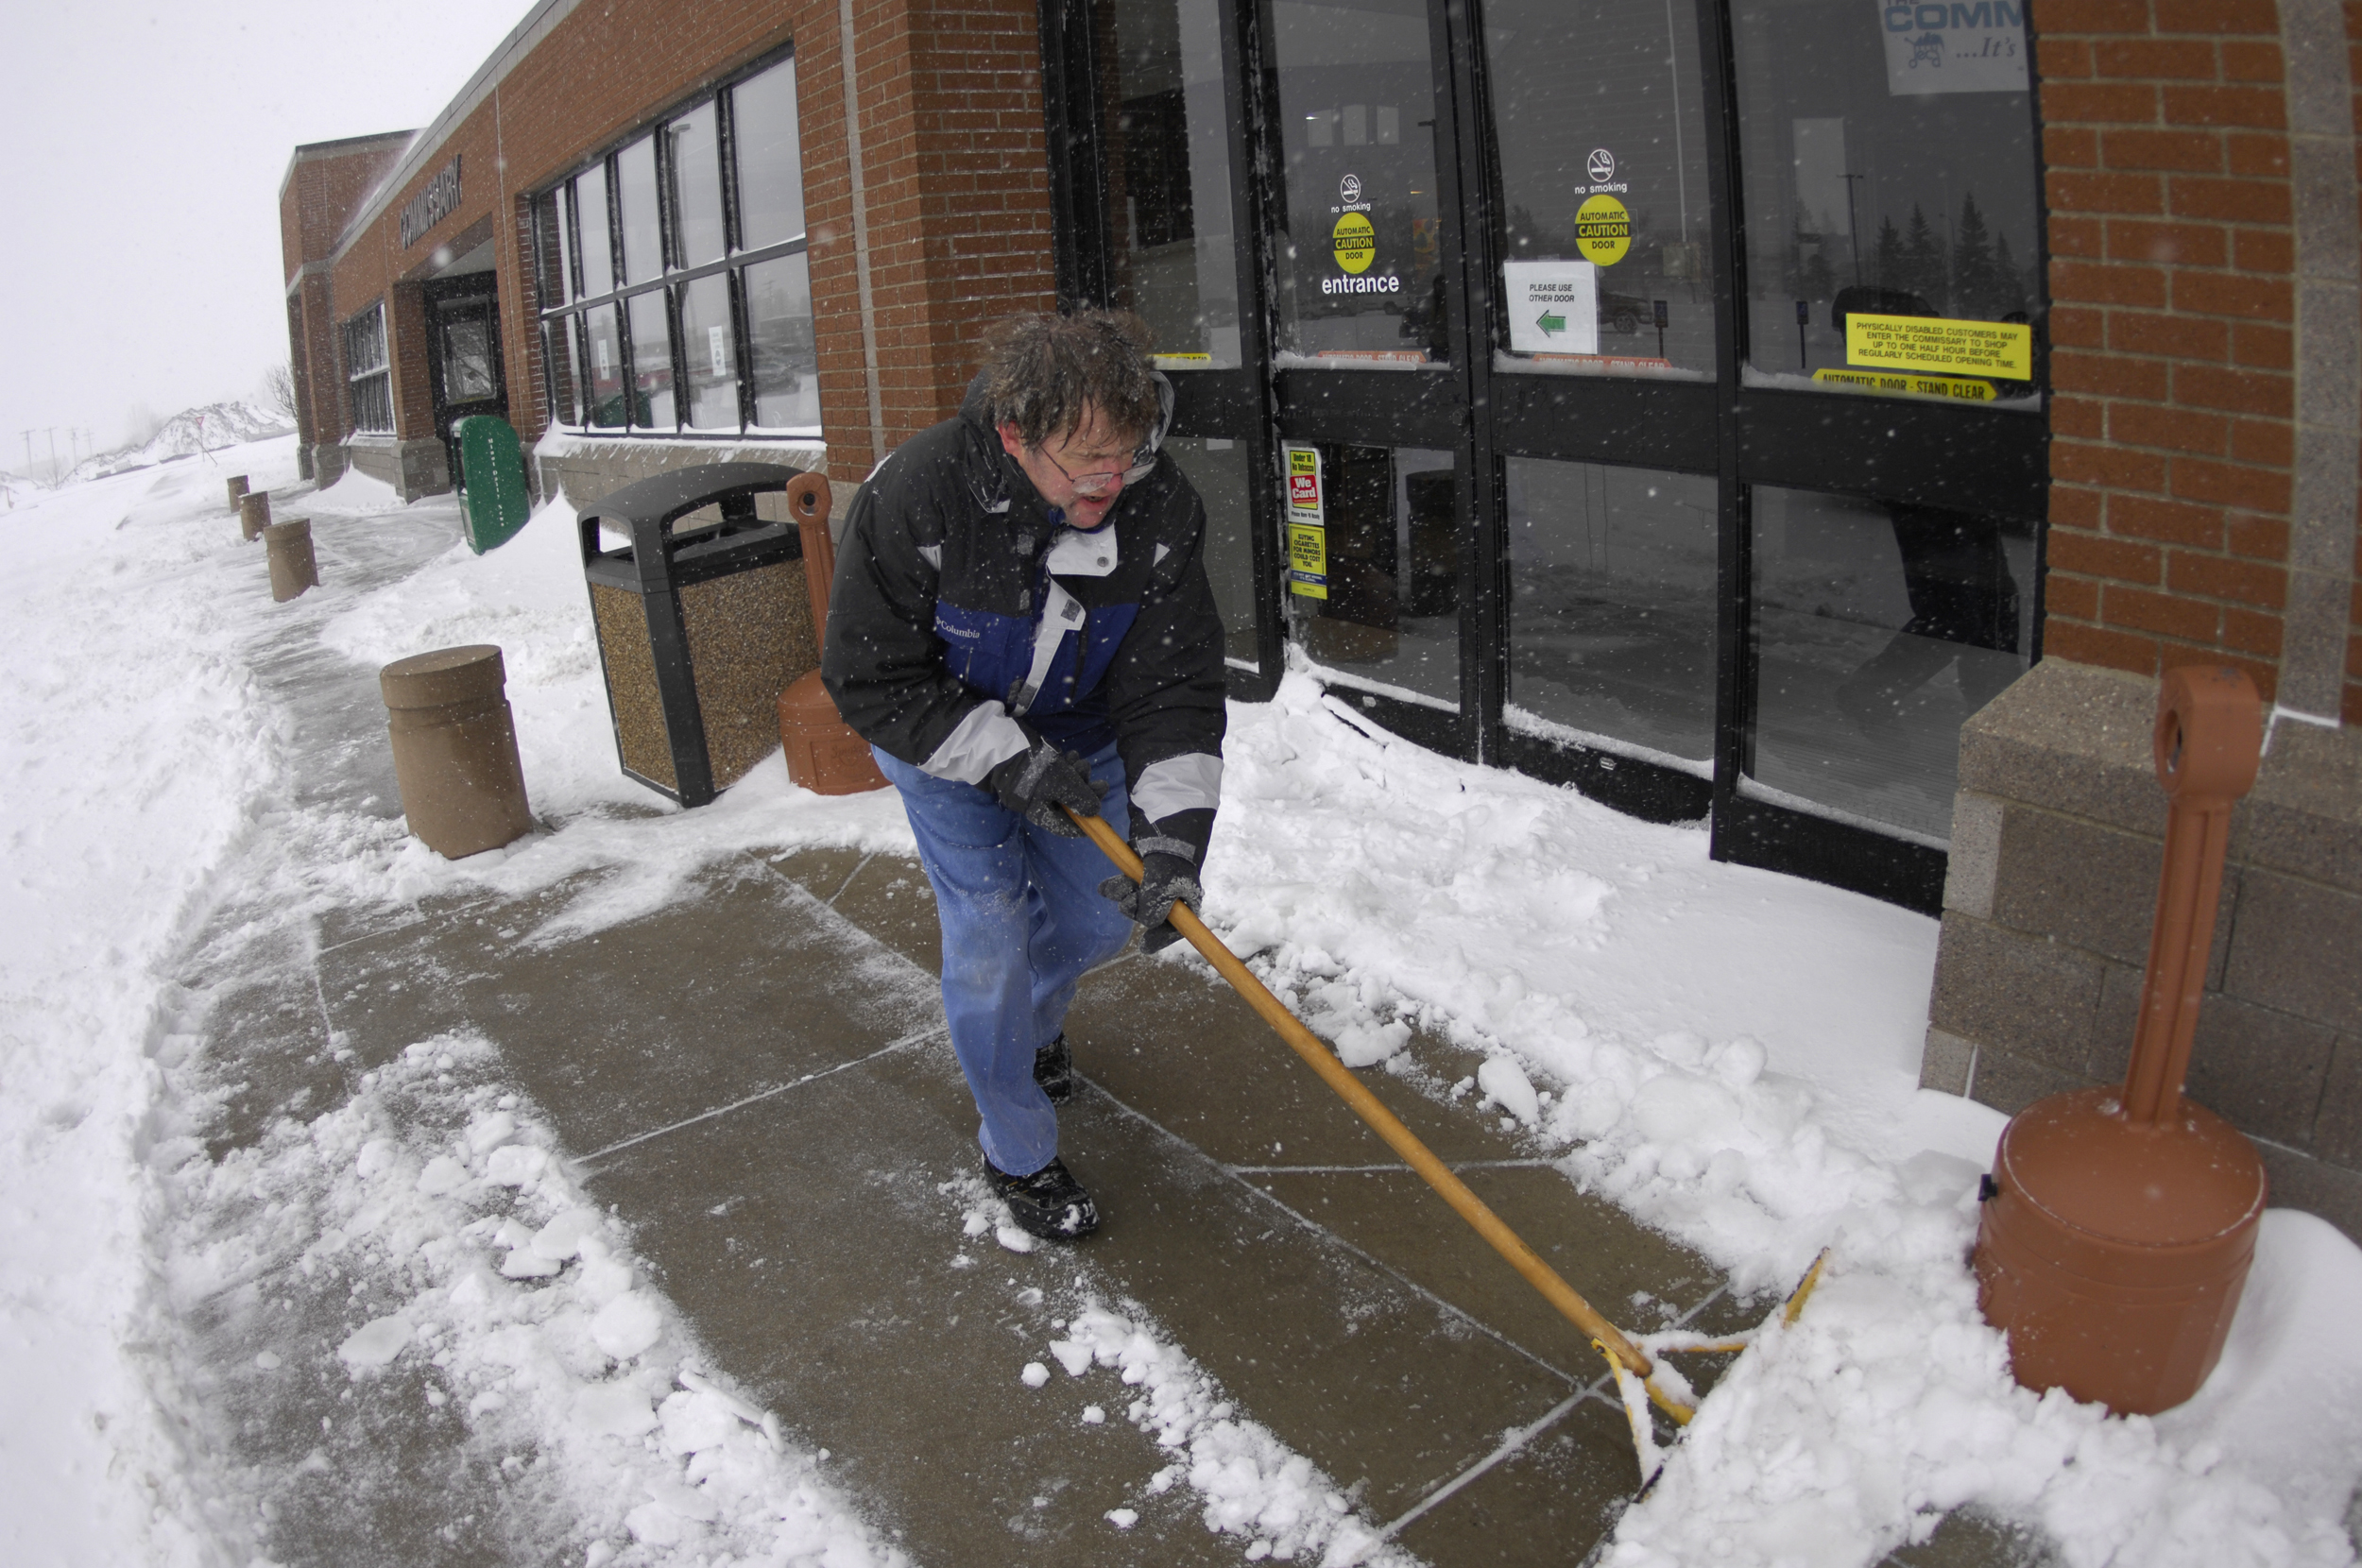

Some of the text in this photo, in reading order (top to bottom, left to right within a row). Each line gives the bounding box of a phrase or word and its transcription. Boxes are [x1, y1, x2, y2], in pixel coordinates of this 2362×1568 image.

[1574, 182, 1627, 195] no smoking
[400, 153, 462, 250] COMMISSARY
[1343, 202, 1371, 213] smoking
[1580, 211, 1625, 222] AUTOMATIC
[1336, 226, 1371, 236] AUTOMATIC
[1579, 224, 1628, 237] CAUTION
[1335, 237, 1373, 249] CAUTION
[1592, 241, 1616, 249] DOOR
[1345, 251, 1363, 260] DOOR
[1322, 274, 1399, 295] entrance
[1529, 283, 1573, 292] PLEASE USE
[1529, 294, 1575, 302] OTHER DOOR
[1857, 322, 2018, 341] PHYSICALLY DISABLED CUSTOMERS MAY
[1866, 332, 2008, 349] ENTER THE COMMISSARY TO SHOP
[1887, 341, 1897, 350] TO
[1900, 342, 1917, 351] ONE
[1920, 344, 1940, 353] HALF
[1943, 346, 1966, 354] HOUR
[1969, 348, 2001, 358] BEFORE
[1858, 349, 1903, 359] REGULARLY
[1906, 351, 1953, 363] SCHEDULED
[1955, 355, 1993, 366] OPENING
[1880, 378, 1907, 391] DOOR
[1916, 381, 1948, 396] STAND
[1953, 383, 1985, 401] CLEAR
[1294, 477, 1312, 488] We
[1292, 486, 1316, 499] Card
[1293, 539, 1320, 549] CIGARETTES
[940, 620, 981, 639] Columbia
